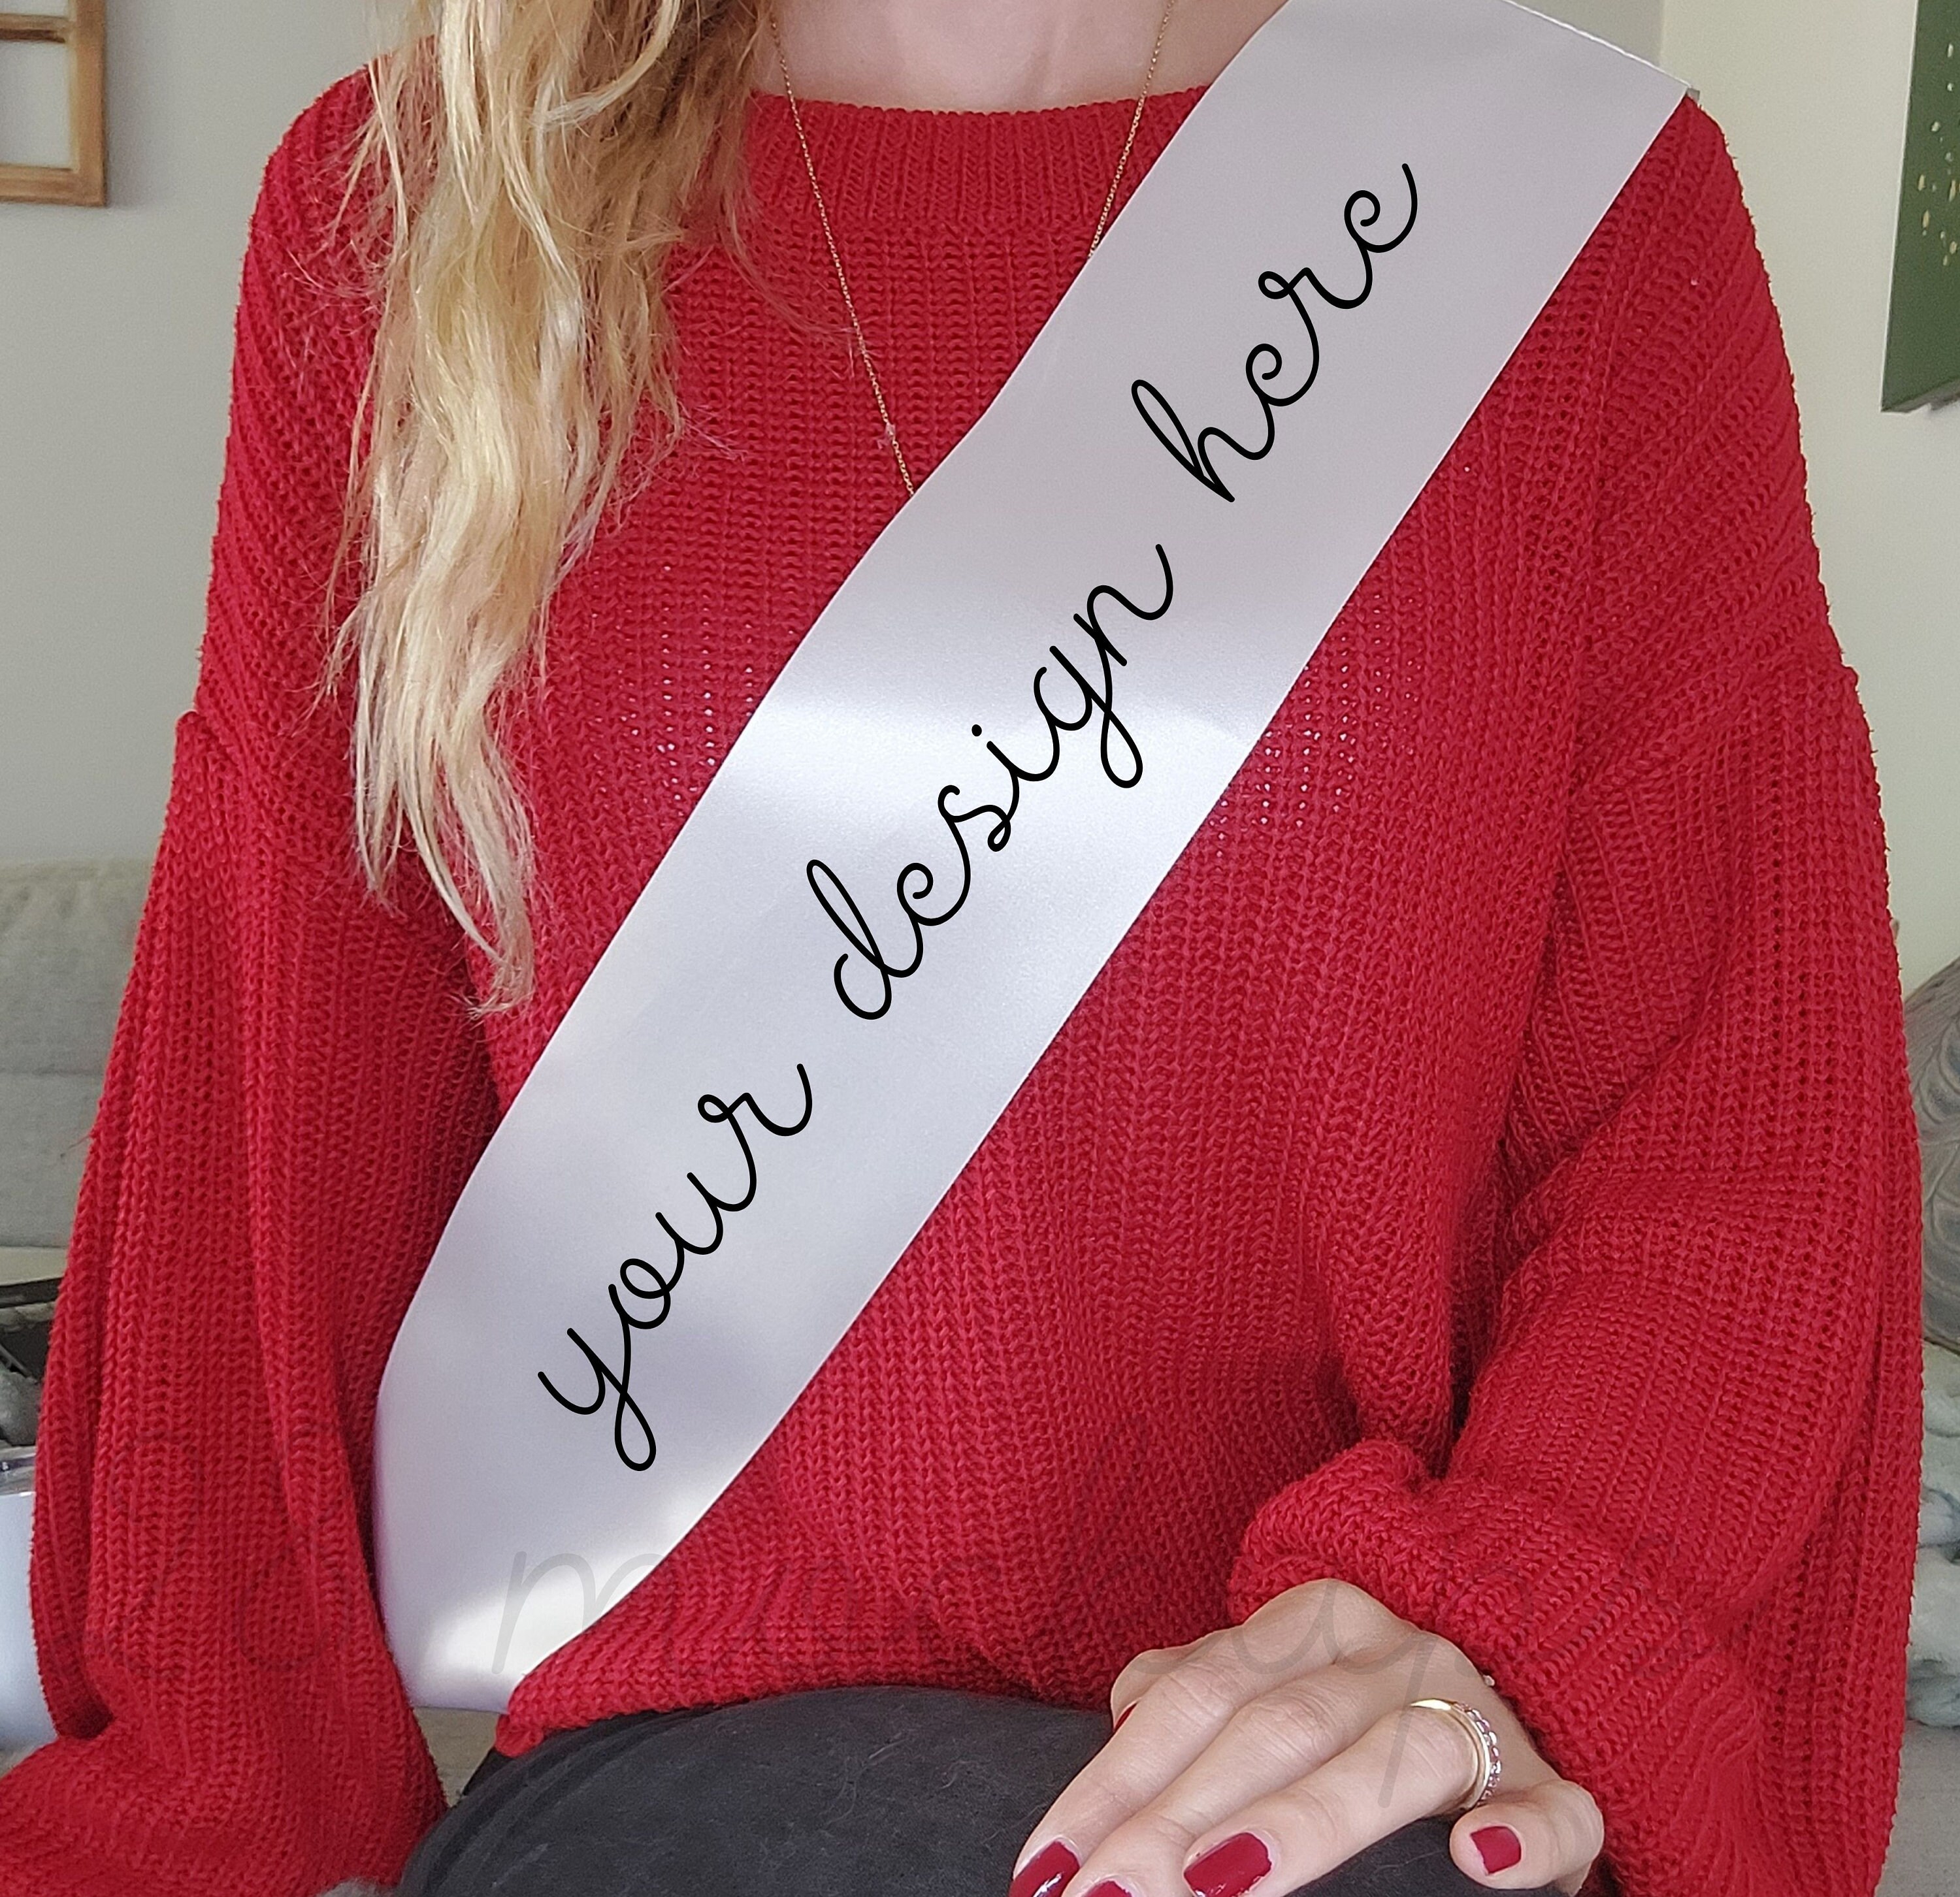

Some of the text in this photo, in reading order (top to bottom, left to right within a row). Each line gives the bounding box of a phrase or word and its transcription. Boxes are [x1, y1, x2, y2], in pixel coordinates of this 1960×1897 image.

[537, 162, 1418, 1472] your design here
